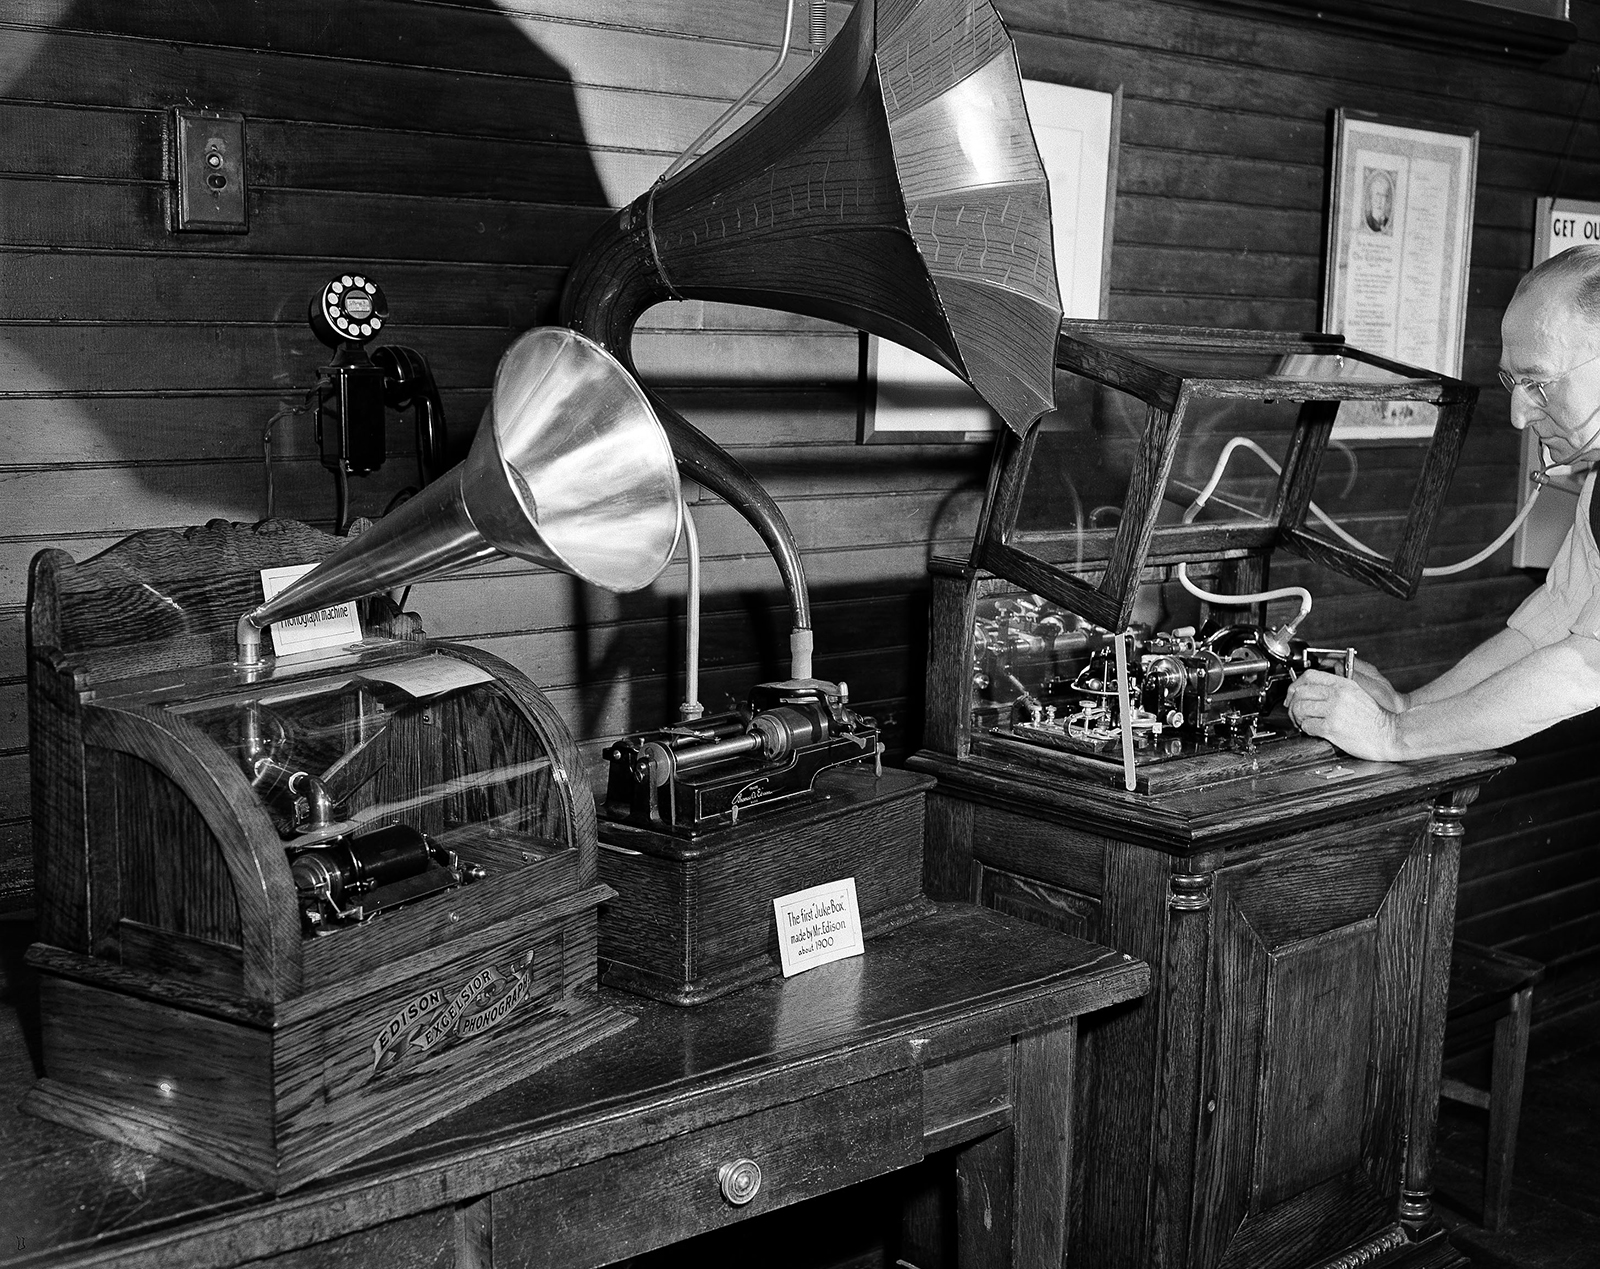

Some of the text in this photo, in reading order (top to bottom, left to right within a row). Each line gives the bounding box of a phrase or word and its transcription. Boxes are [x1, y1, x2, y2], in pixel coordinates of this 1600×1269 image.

[1553, 218, 1576, 238] GET
[321, 604, 349, 621] machine
[787, 911, 801, 927] The
[800, 907, 814, 923] first
[790, 929, 806, 945] made
[805, 927, 813, 942] by
[821, 920, 847, 935] Edison
[798, 936, 834, 957] about 1900
[425, 970, 492, 1045] EXCELSIOR
[379, 991, 440, 1050] EDISON
